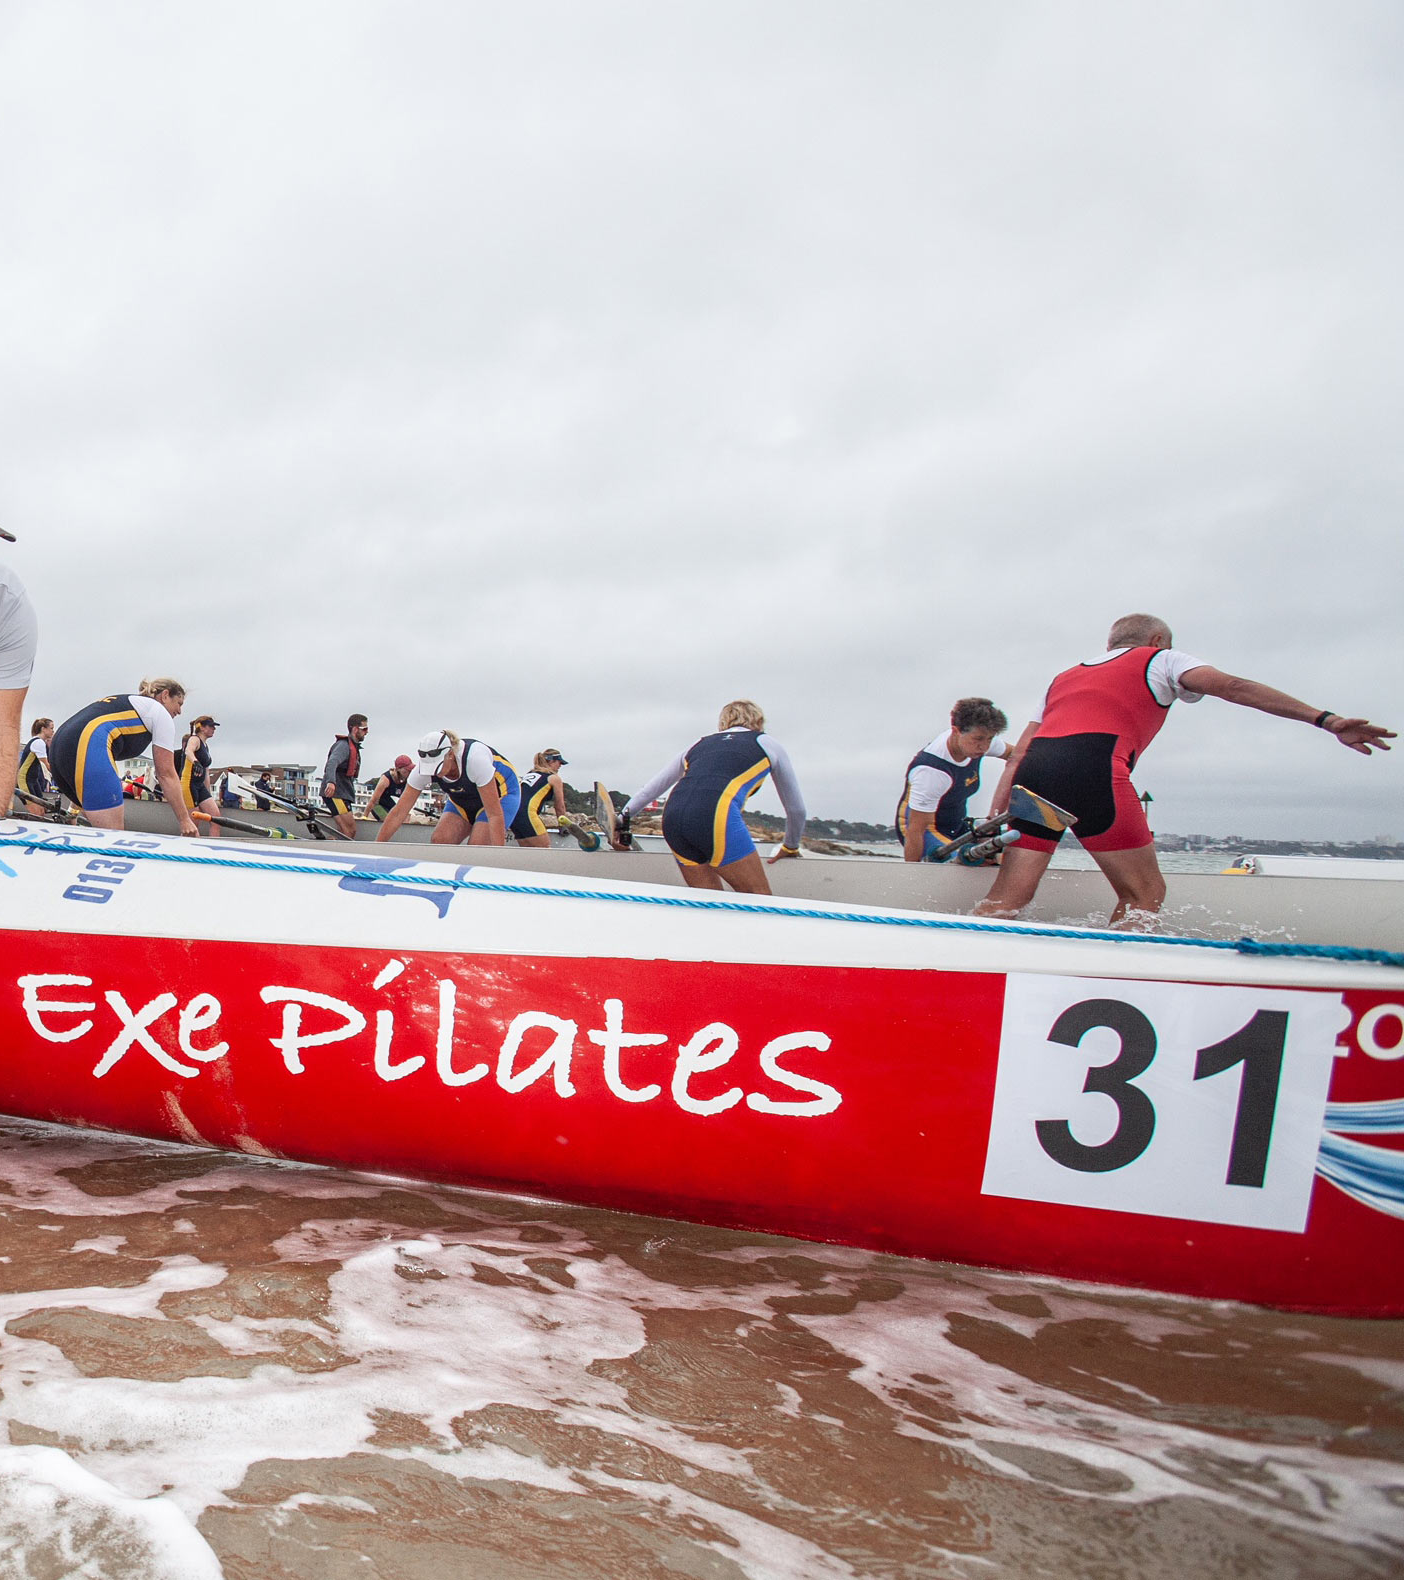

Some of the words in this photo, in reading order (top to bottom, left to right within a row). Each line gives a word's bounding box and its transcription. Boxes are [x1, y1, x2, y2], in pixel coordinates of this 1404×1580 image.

[18, 973, 231, 1079] Exe
[260, 958, 843, 1117] Pilates
[1034, 997, 1290, 1189] 31
